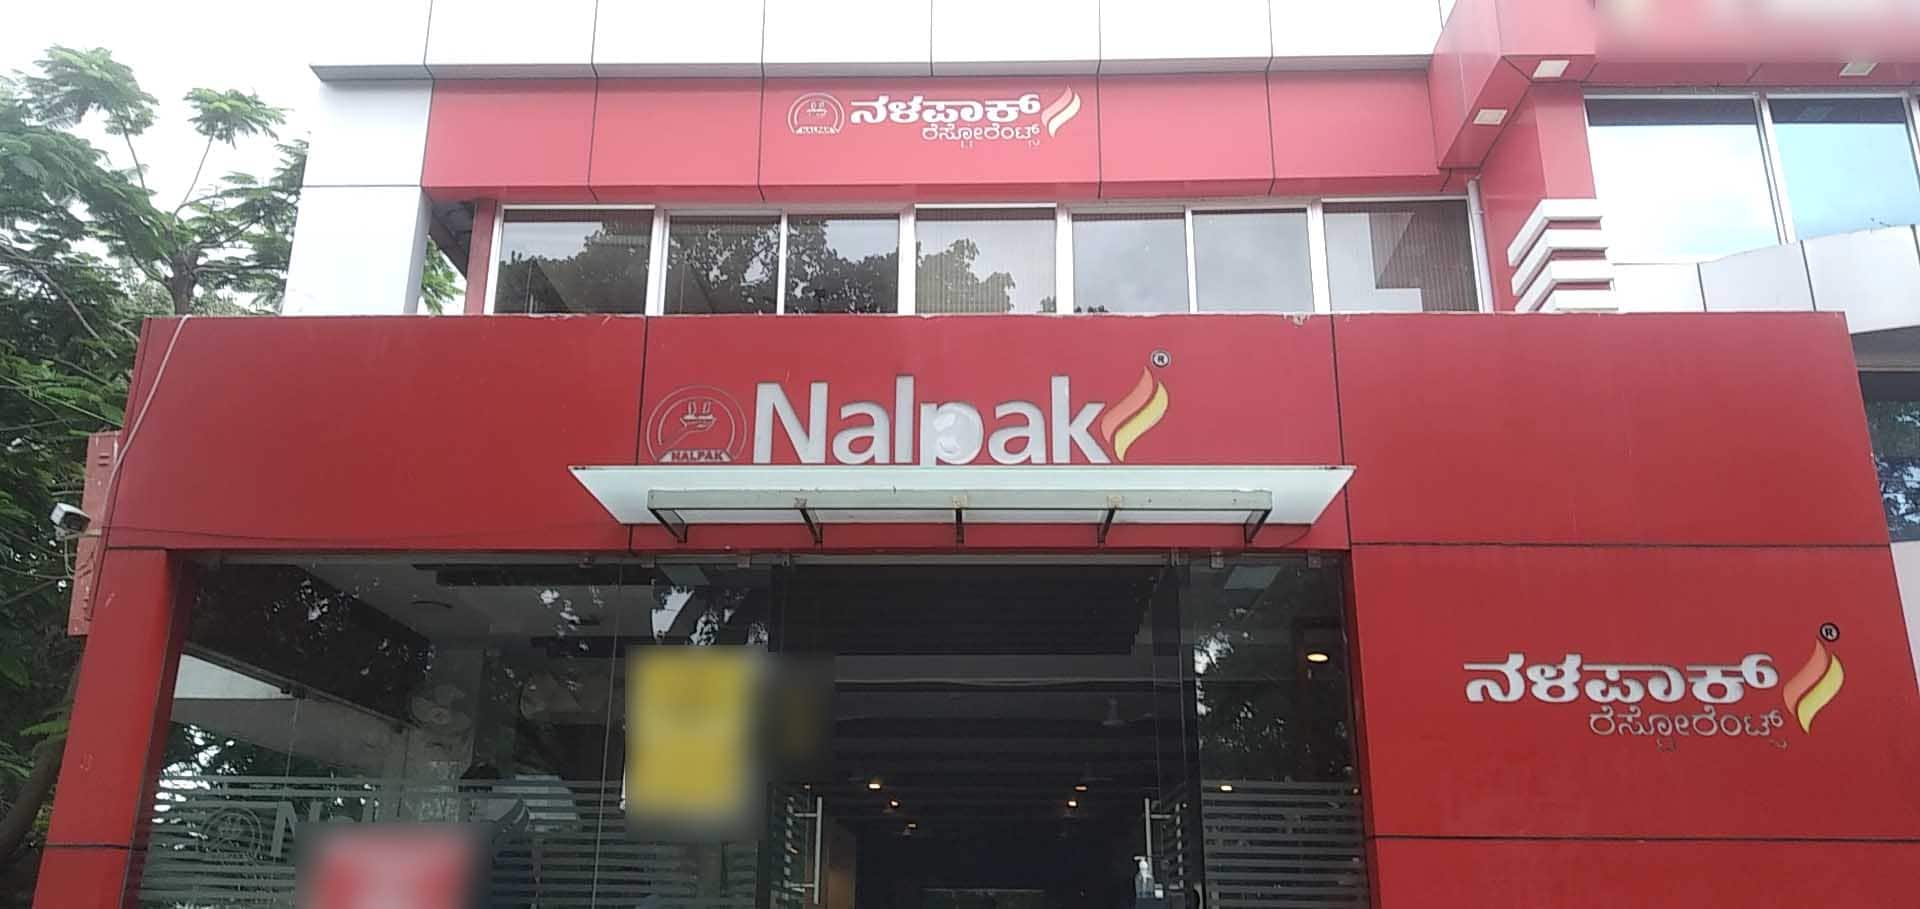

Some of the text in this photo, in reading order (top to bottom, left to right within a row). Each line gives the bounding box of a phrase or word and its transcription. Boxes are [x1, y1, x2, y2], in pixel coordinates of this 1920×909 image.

[850, 94, 1041, 124] ನಳಪಾಕ್
[753, 375, 1112, 464] Nalpak
[671, 450, 723, 461] NALPAK
[1463, 652, 1779, 703] ನಳಪಾಕ್
